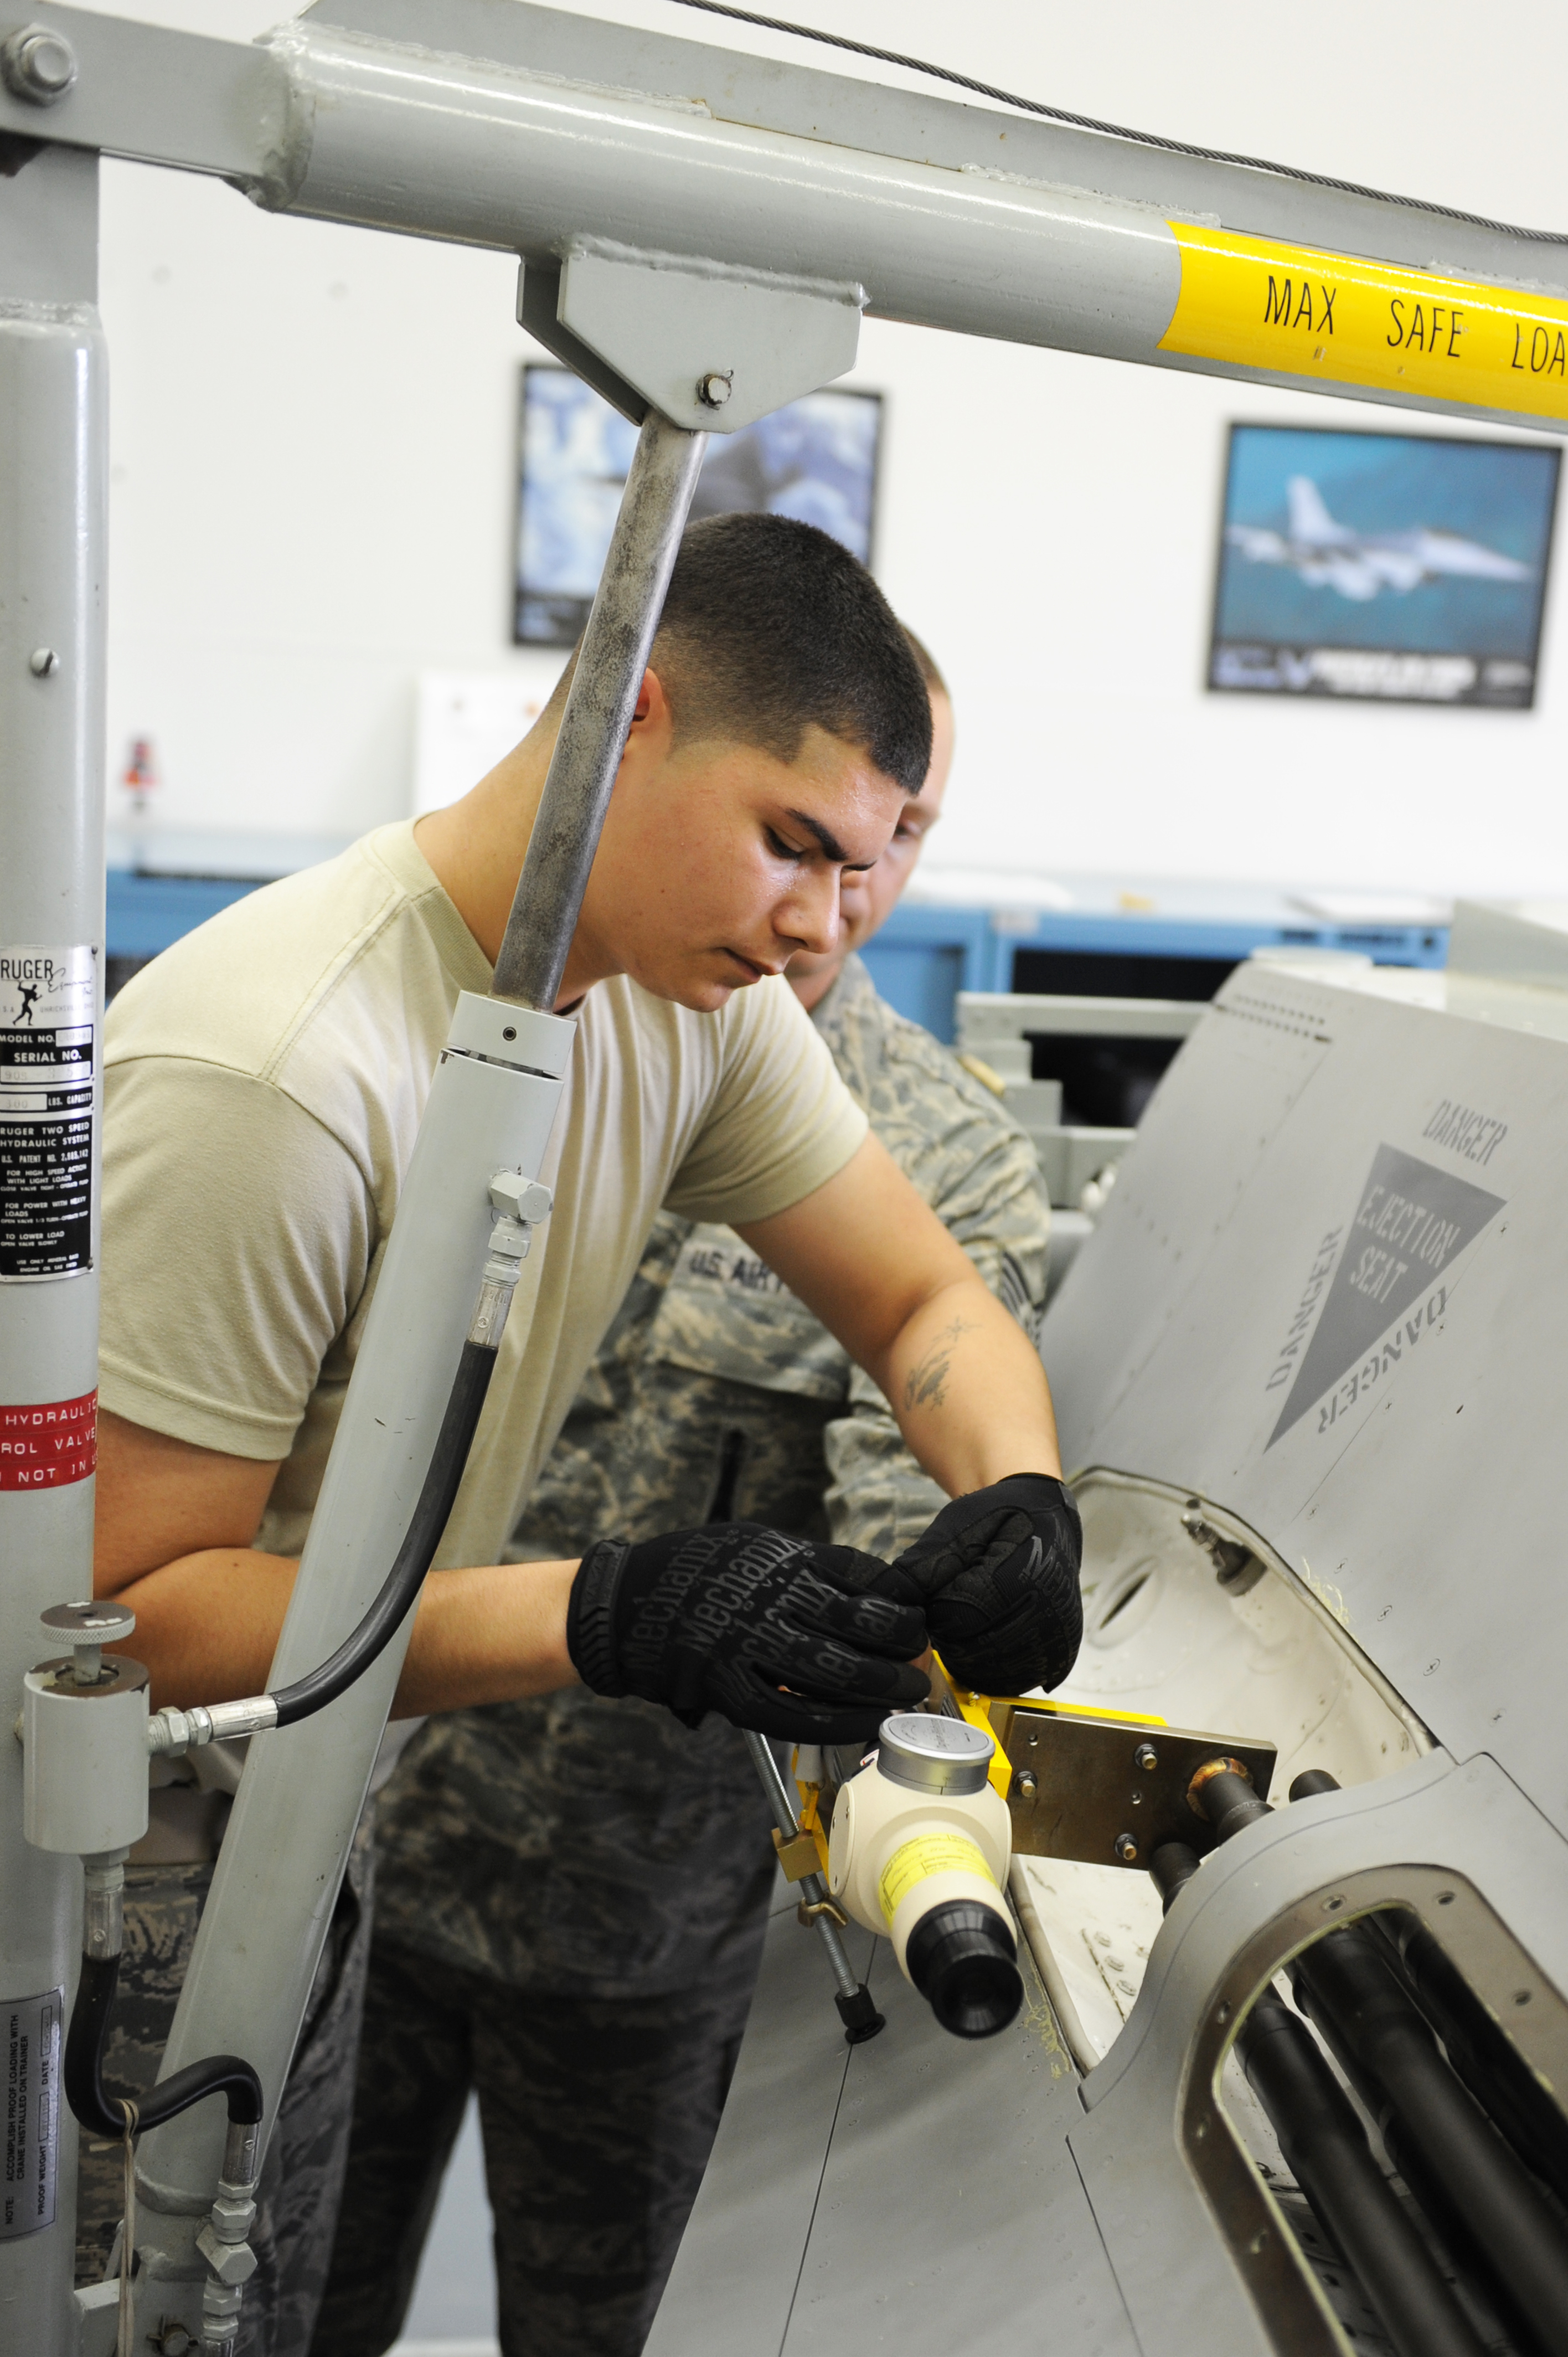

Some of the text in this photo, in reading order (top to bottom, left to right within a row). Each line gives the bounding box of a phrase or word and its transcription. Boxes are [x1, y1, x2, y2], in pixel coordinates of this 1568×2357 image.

[1264, 275, 1565, 377] MAX SAFE LOA
[1, 959, 53, 979] RUGER
[0, 1035, 33, 1043] MODEL
[14, 1049, 82, 1062] SERIAL NO.
[0, 1121, 89, 1135] RUGER TWO SPEED
[0, 1134, 89, 1147] HYDRAULIC SYSTEM
[1422, 1099, 1508, 1166] DANGER
[19, 1155, 41, 1163] PATENT
[1357, 1184, 1461, 1268] EJECTION
[1349, 1245, 1409, 1304] SEAT
[1266, 1224, 1344, 1391] DANGER
[1318, 1286, 1447, 1434] DANGER
[6, 1398, 96, 1425] HYDRAULIC
[1, 1427, 95, 1454] ROL VALVE
[18, 1468, 55, 1482] NOT
[72, 1460, 86, 1474] IN
[676, 1530, 806, 1657] Mechanix
[9, 2042, 18, 2083] LOADING
[19, 2078, 27, 2093] ON
[8, 2087, 17, 2118] PROOF
[18, 2096, 27, 2146] INSTALLED
[7, 2121, 16, 2181] ACCOMPLISH
[6, 2196, 14, 2224] NOTE:
